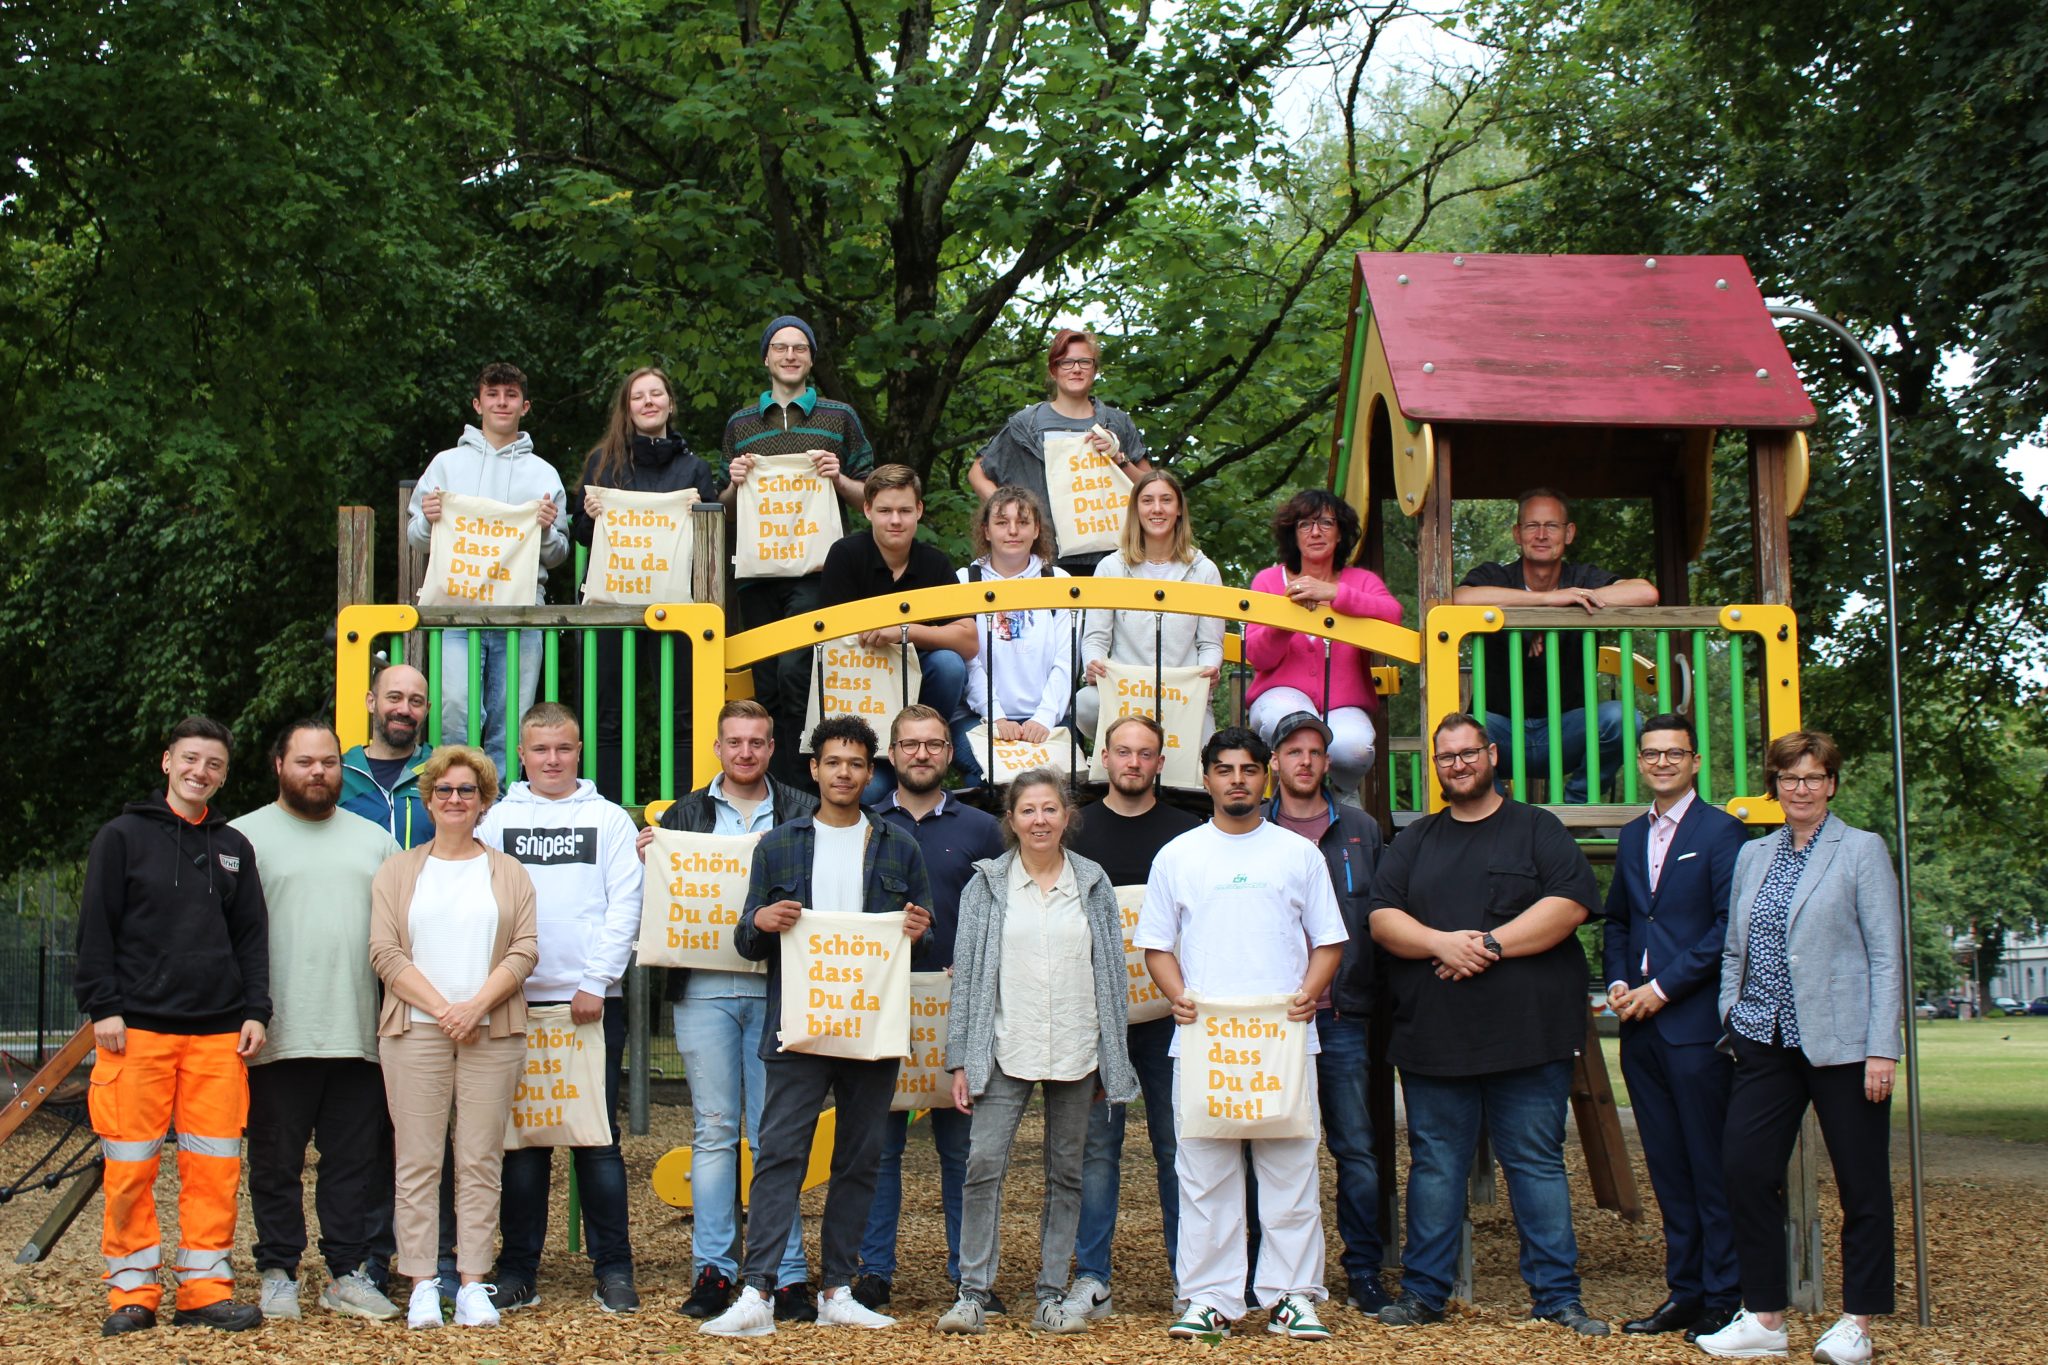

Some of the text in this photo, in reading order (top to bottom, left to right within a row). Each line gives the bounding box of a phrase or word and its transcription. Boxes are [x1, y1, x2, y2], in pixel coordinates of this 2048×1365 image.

[758, 474, 823, 493] Schön,
[1072, 476, 1113, 493] dass
[758, 497, 803, 515] dass
[1074, 492, 1130, 514] Du da
[454, 516, 525, 541] Schön,
[607, 509, 677, 531] Schön,
[759, 518, 819, 538] Du da
[1075, 514, 1119, 535] bist!
[453, 537, 500, 557] dass
[608, 530, 653, 548] dass
[608, 552, 669, 571] Du da
[757, 541, 804, 560] bist!
[450, 559, 512, 581] Du da
[447, 577, 494, 602] bist!
[605, 573, 651, 594] bist!
[827, 648, 894, 675] Schön,
[825, 671, 872, 690] dass
[824, 695, 886, 714] Du da
[996, 748, 1028, 758] Du
[1001, 748, 1050, 769] bist!
[670, 852, 747, 877] Schön,
[669, 876, 721, 898] dass
[669, 902, 738, 925] Du da
[666, 927, 719, 950] bist!
[808, 934, 890, 961] Schön,
[808, 960, 863, 982] dass
[808, 988, 881, 1011] Du da
[806, 1013, 862, 1038] bist!
[1206, 1016, 1287, 1041] Schön,
[527, 1027, 583, 1051] chön,
[1208, 1042, 1262, 1065] dass
[523, 1059, 562, 1075] ass
[513, 1078, 580, 1102] Du da
[895, 1072, 936, 1093] ist!
[1208, 1069, 1282, 1092] Du da
[512, 1105, 562, 1128] bist!
[1206, 1096, 1264, 1120] bist!
